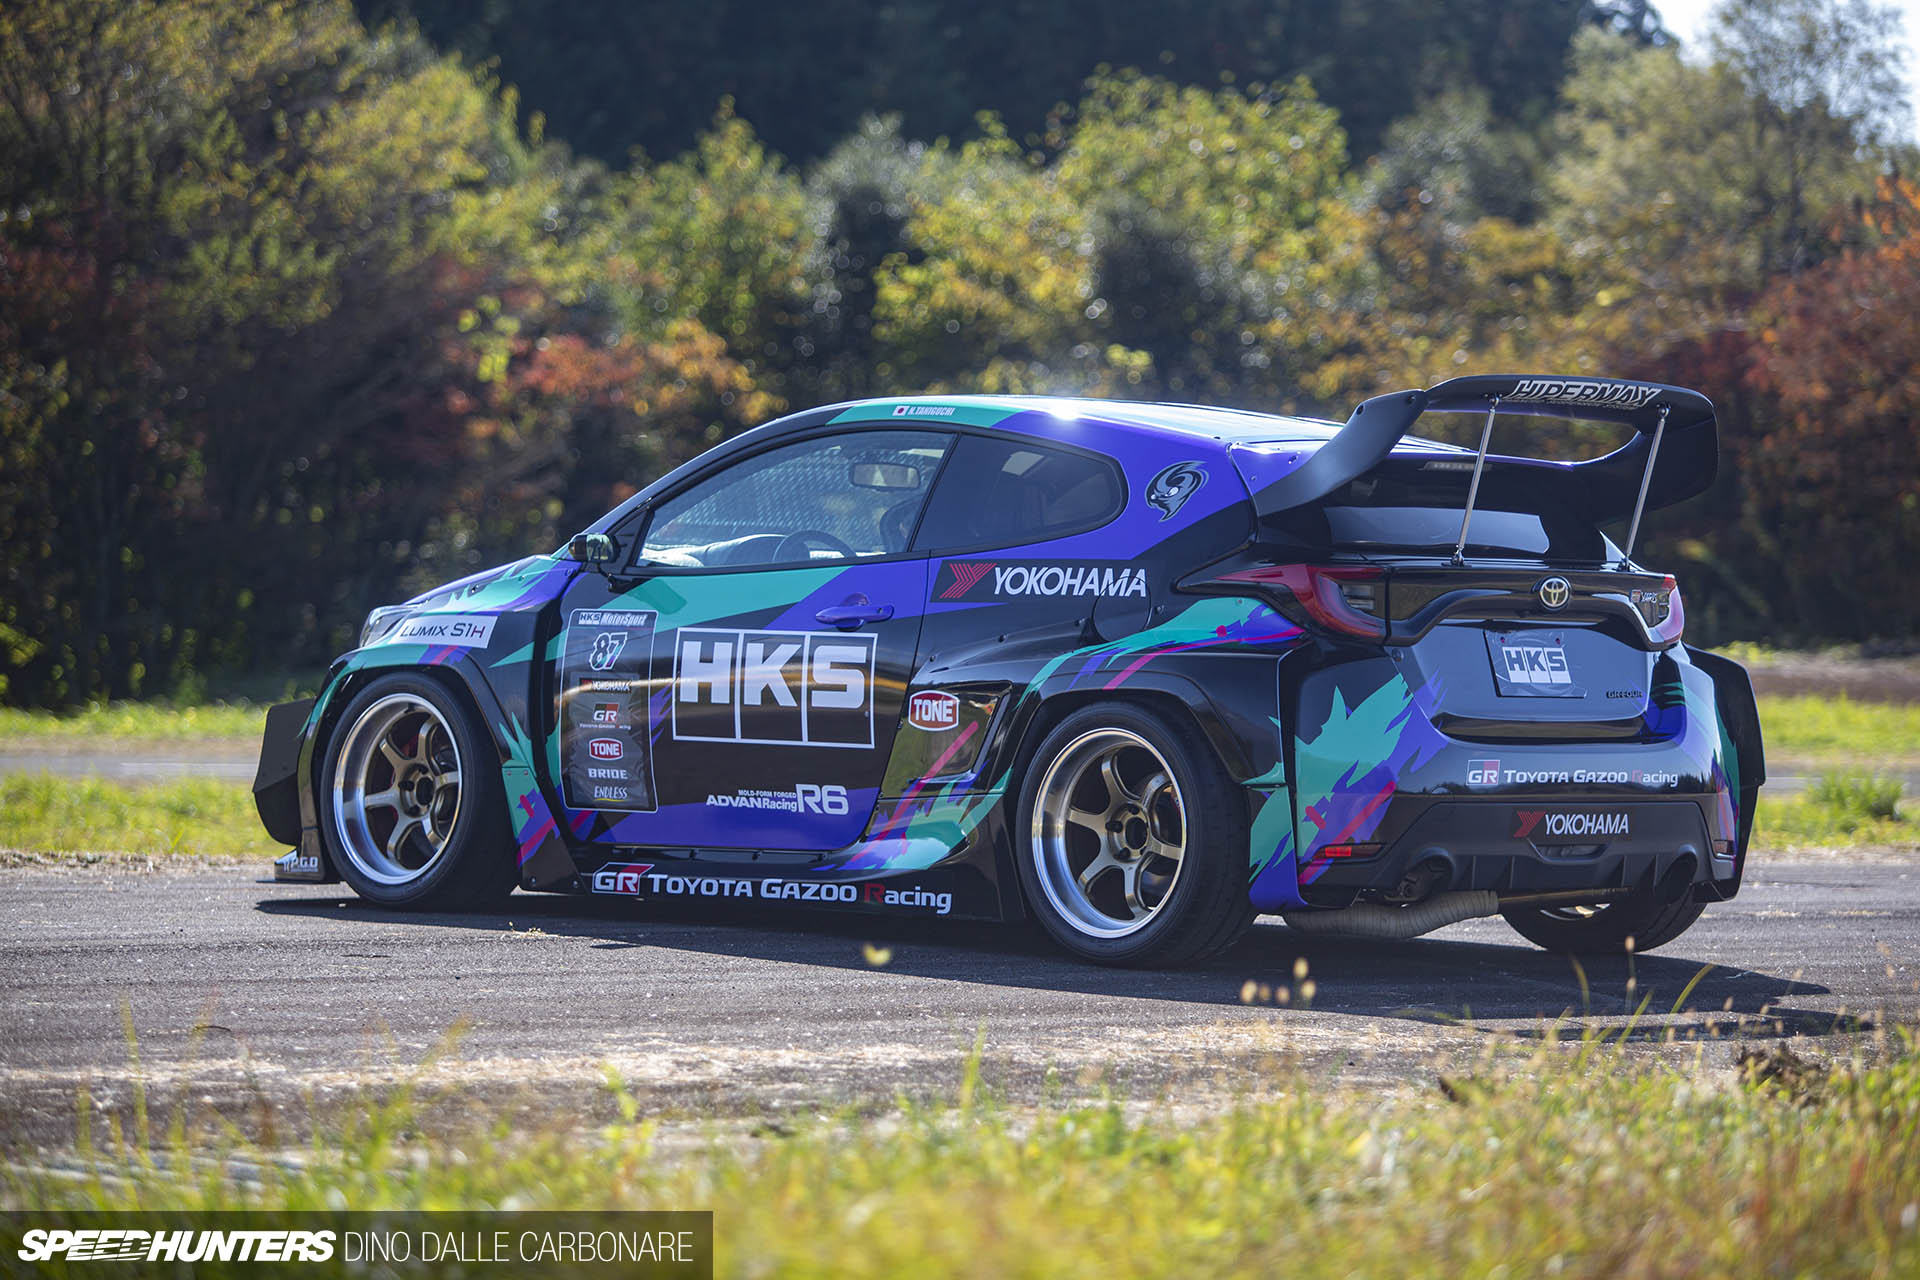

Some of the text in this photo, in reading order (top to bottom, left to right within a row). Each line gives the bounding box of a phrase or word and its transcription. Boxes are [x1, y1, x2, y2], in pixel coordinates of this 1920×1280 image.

[994, 566, 1147, 597] YOKOHAMA
[400, 622, 486, 638] LUMIX S1H
[600, 613, 648, 626] MotorSport
[589, 632, 628, 671] 87
[1504, 648, 1569, 676] HKS
[679, 640, 867, 709] HKS
[593, 710, 618, 721] GR
[914, 699, 954, 722] TONE
[592, 743, 620, 756] TONE
[588, 768, 628, 780] BRIDE
[1468, 769, 1678, 788] GR TOYOTA GAZOO Racing
[594, 786, 628, 800] ENDLESS
[796, 784, 849, 815] R6
[1545, 814, 1629, 835] YOKOHAMA
[594, 872, 952, 914] GR TOYOTA GAZOO Racing
